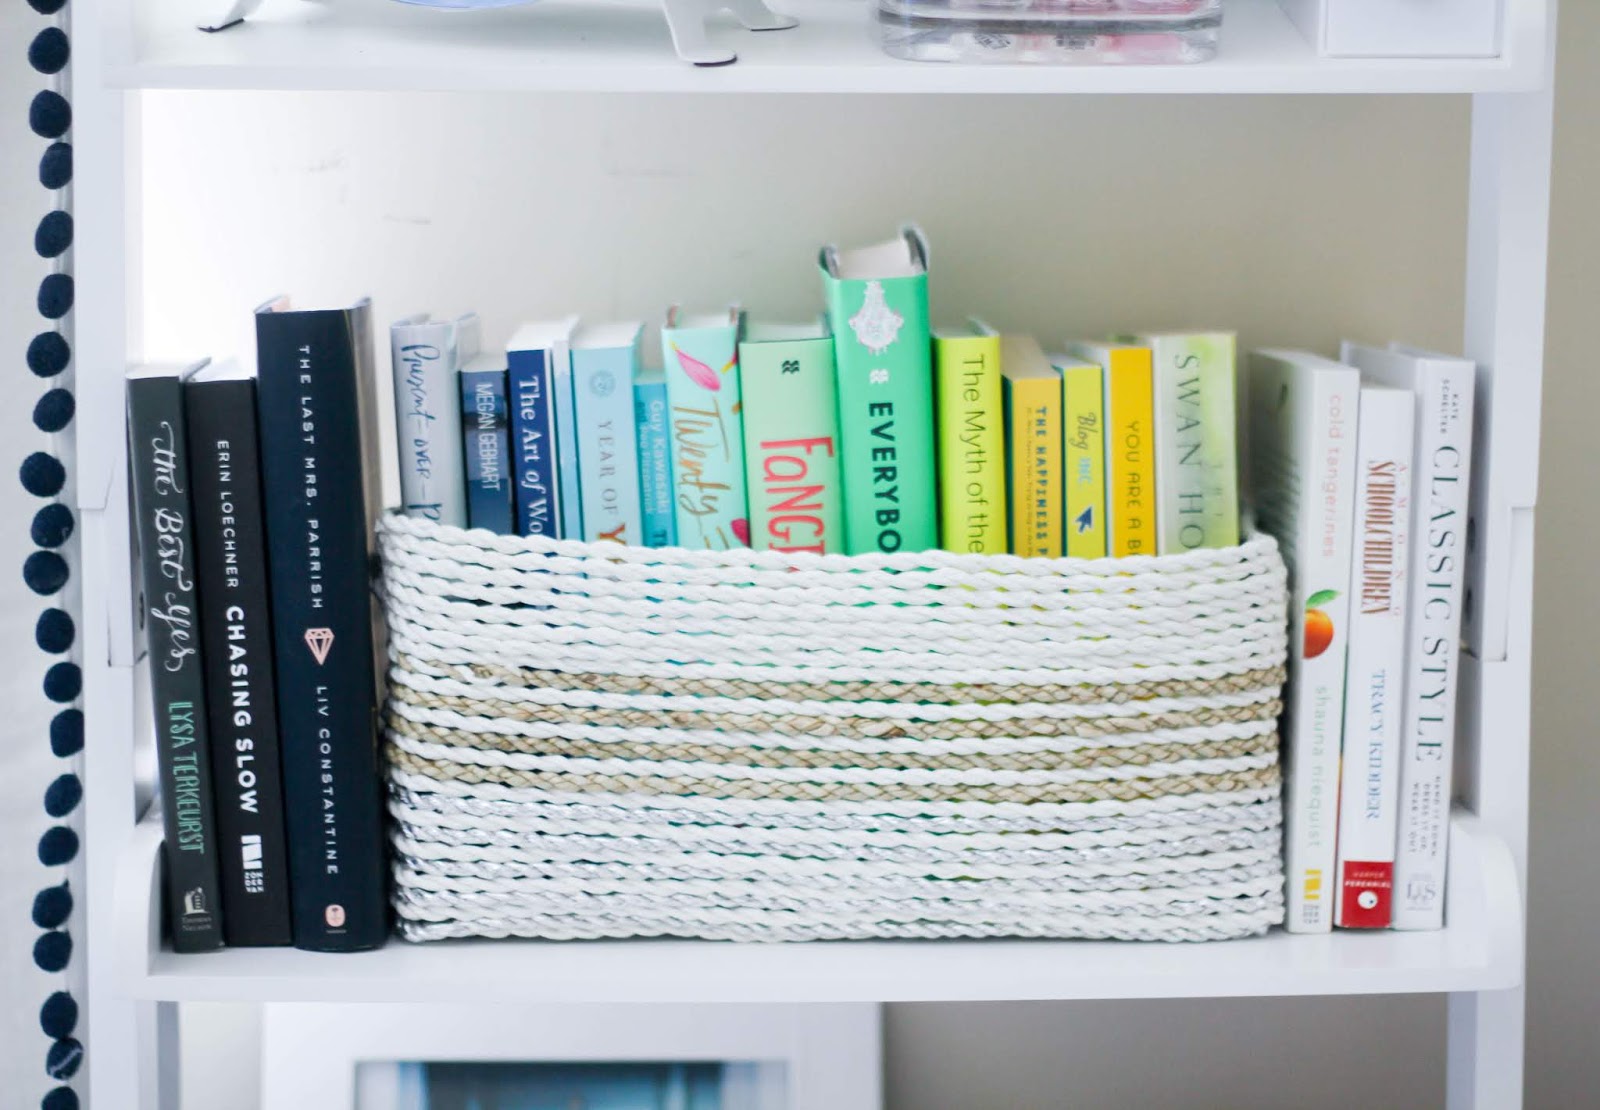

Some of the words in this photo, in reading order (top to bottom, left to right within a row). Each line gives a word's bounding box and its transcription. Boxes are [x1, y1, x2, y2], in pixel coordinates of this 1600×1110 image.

[298, 344, 311, 385] THE
[961, 354, 985, 403] The
[300, 396, 316, 446] LAST
[475, 383, 496, 431] MEGAN
[518, 375, 541, 421] The
[649, 399, 665, 432] Guy
[1035, 406, 1047, 437] THE
[1174, 354, 1201, 467] SWAN
[1329, 394, 1344, 439] cold
[521, 427, 544, 463] Art
[597, 420, 616, 479] YEAR
[959, 410, 987, 474] Myth
[1068, 411, 1098, 450] Blog
[1126, 420, 1140, 464] YOU
[216, 439, 231, 483] ERIN
[303, 456, 318, 507] MRS.
[477, 431, 502, 493] GEBHART
[521, 471, 546, 496] of
[653, 437, 670, 514] Kawasaki
[672, 397, 731, 536] Twenty
[868, 401, 903, 555] EVERYBO
[1126, 472, 1141, 508] ARE
[601, 487, 619, 516] OF
[966, 480, 988, 507] of
[1035, 446, 1049, 541] HAPPINESS
[1322, 447, 1342, 558] tangerines
[155, 507, 194, 592] Best
[220, 491, 240, 589] LOECHNER
[967, 510, 993, 554] the
[1127, 518, 1142, 530] A
[1360, 460, 1398, 616] SCHOOLCHILDREN
[1423, 445, 1459, 621] CLASSIC
[306, 519, 324, 609] PARRISH
[225, 605, 252, 728] CHASING
[168, 701, 197, 749] LYSA
[316, 685, 330, 717] LIV
[1311, 685, 1331, 757] shauna
[1371, 668, 1386, 733] TRACY
[1415, 637, 1449, 762] STYLE
[173, 751, 205, 855] TERKEURST
[234, 737, 260, 815] SLOW
[318, 727, 339, 876] CONSTANTINE
[1365, 742, 1384, 821] KIDDER
[1306, 765, 1325, 848] niequist
